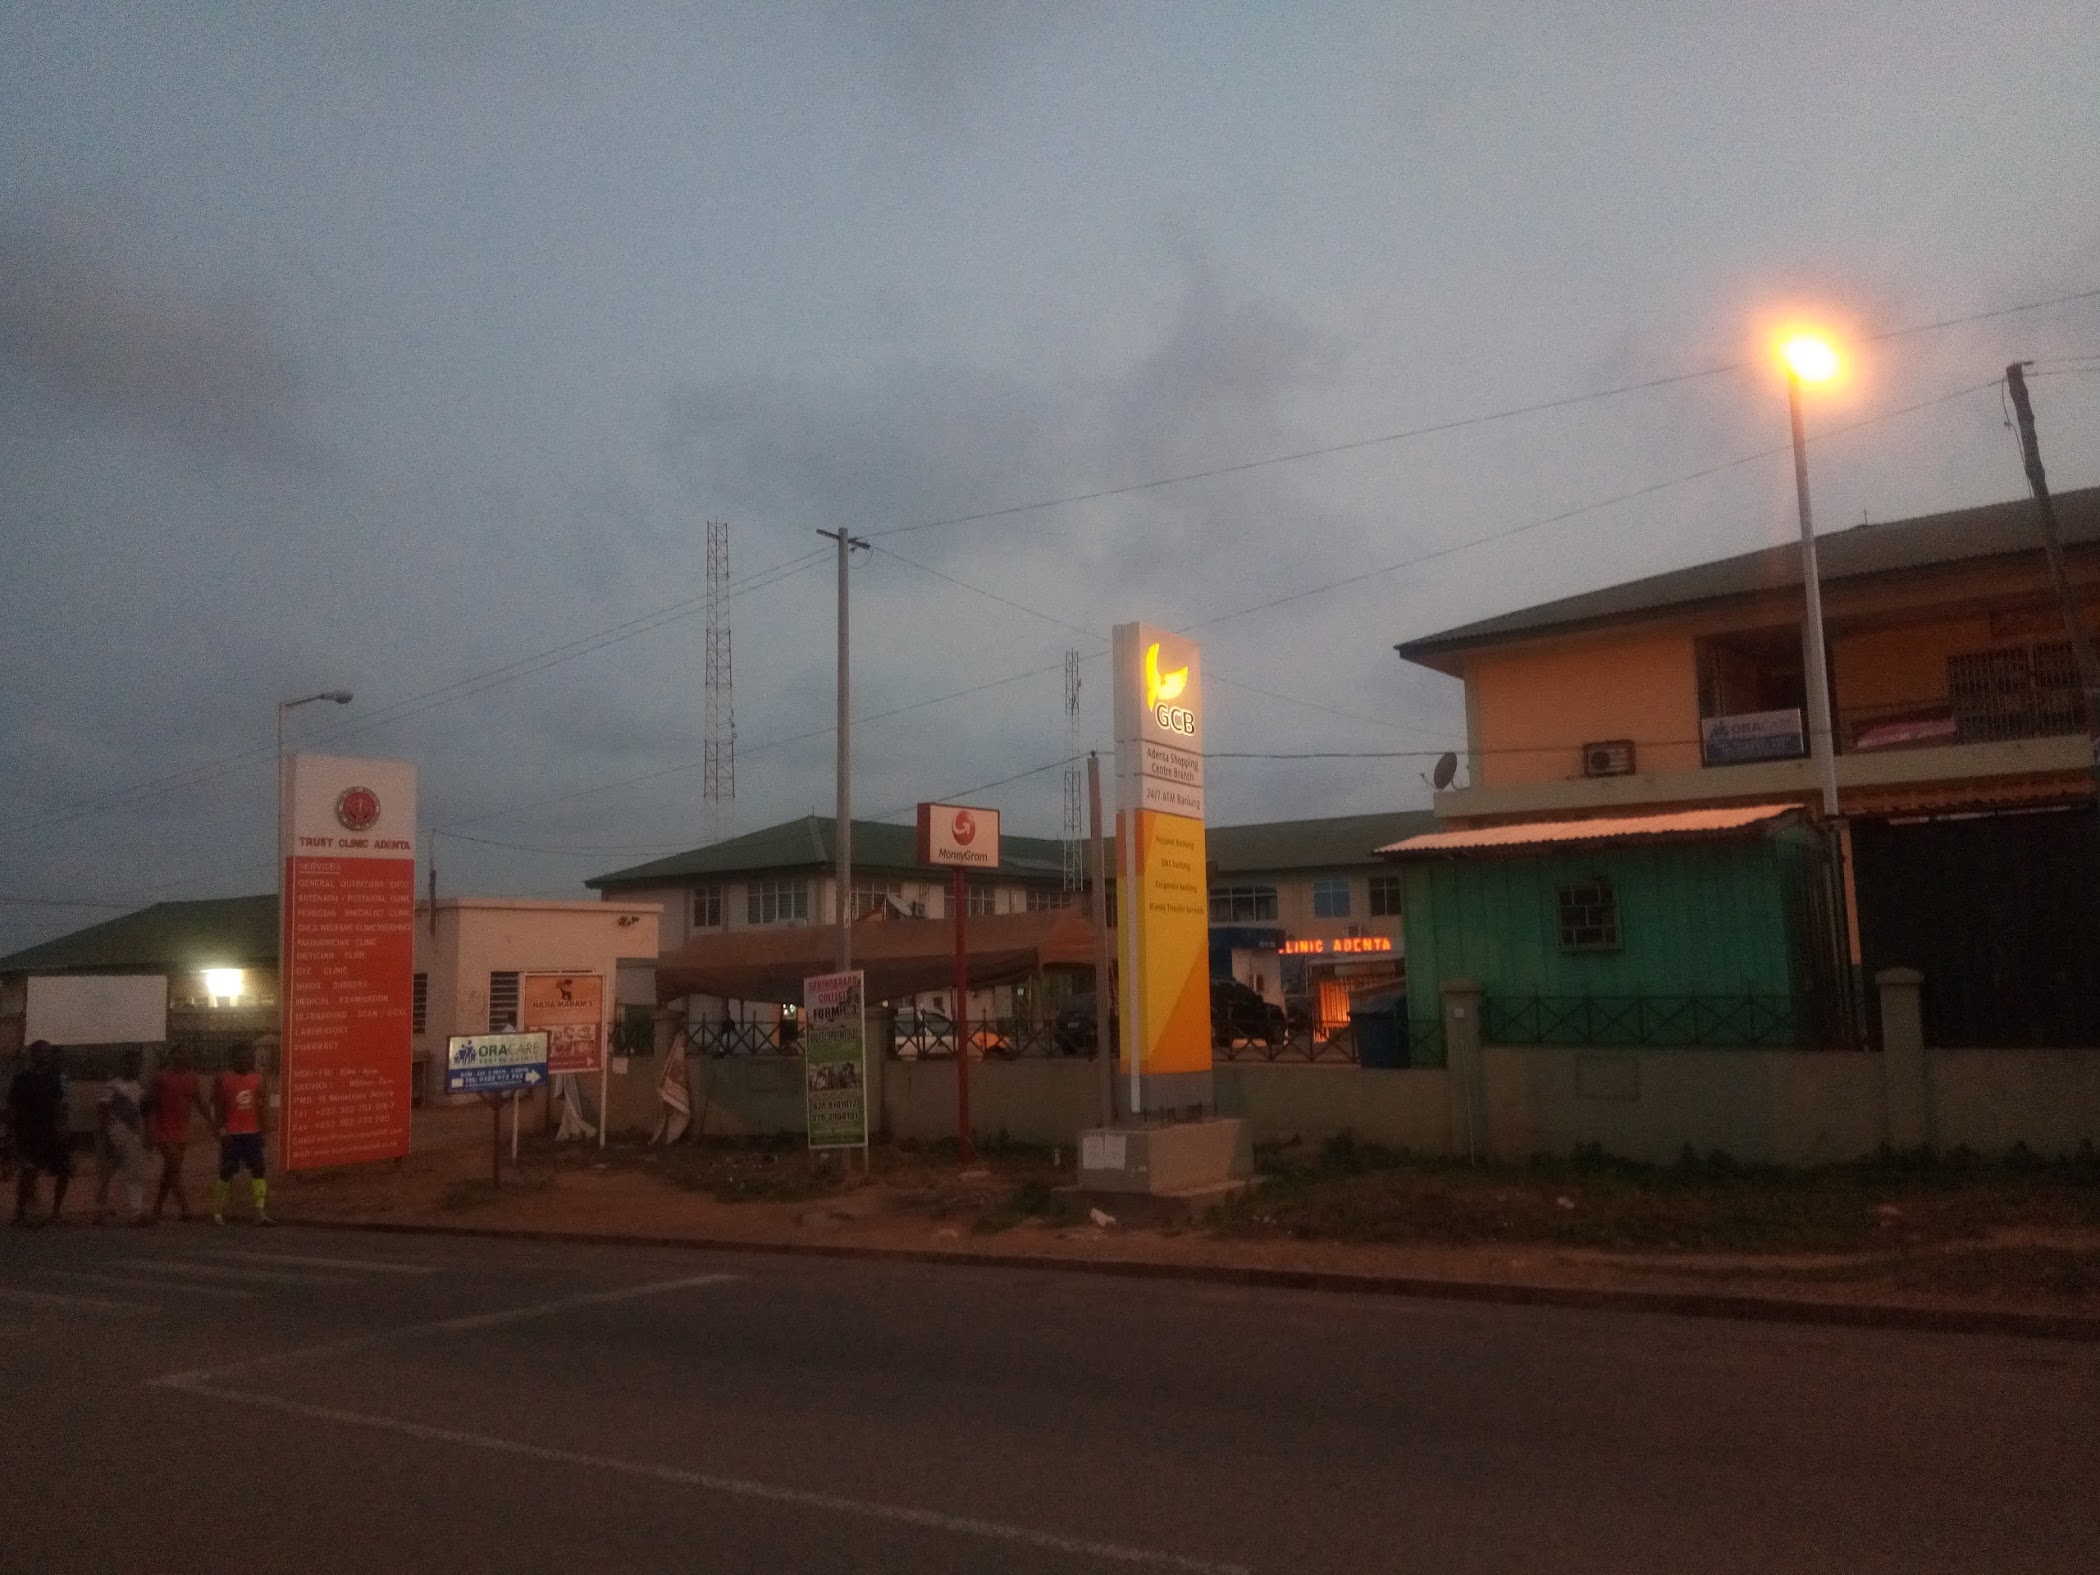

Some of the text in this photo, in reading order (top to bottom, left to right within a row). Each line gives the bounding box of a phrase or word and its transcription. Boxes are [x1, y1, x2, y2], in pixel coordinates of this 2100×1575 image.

[1156, 703, 1196, 735] GCB
[1147, 747, 1199, 772] Adenta Shopping
[1151, 763, 1195, 782] Centre Branch
[1146, 787, 1201, 810] 24/7 ATM Banking
[299, 836, 411, 850] TRUST CLINIC ADENTA
[938, 848, 988, 863] MoneyGram
[297, 879, 335, 889] GENERAL
[297, 908, 336, 918] PHYSICIAN
[344, 908, 385, 918] SPECIALIST
[320, 924, 353, 933] WELFARE
[1279, 940, 1324, 954] LINIC
[1333, 937, 1392, 953] ADENTA
[295, 966, 348, 976] EYE CLINIC
[295, 980, 368, 991] MINOR SURGERY
[295, 994, 389, 1006] MEDICAL EXAMINATION
[295, 1011, 347, 1021] ULTRASOUND
[357, 1009, 378, 1018] SCAN
[295, 1026, 349, 1037] LABORATORY
[294, 1041, 339, 1051] PHARMACY
[478, 1041, 540, 1057] ORACARE
